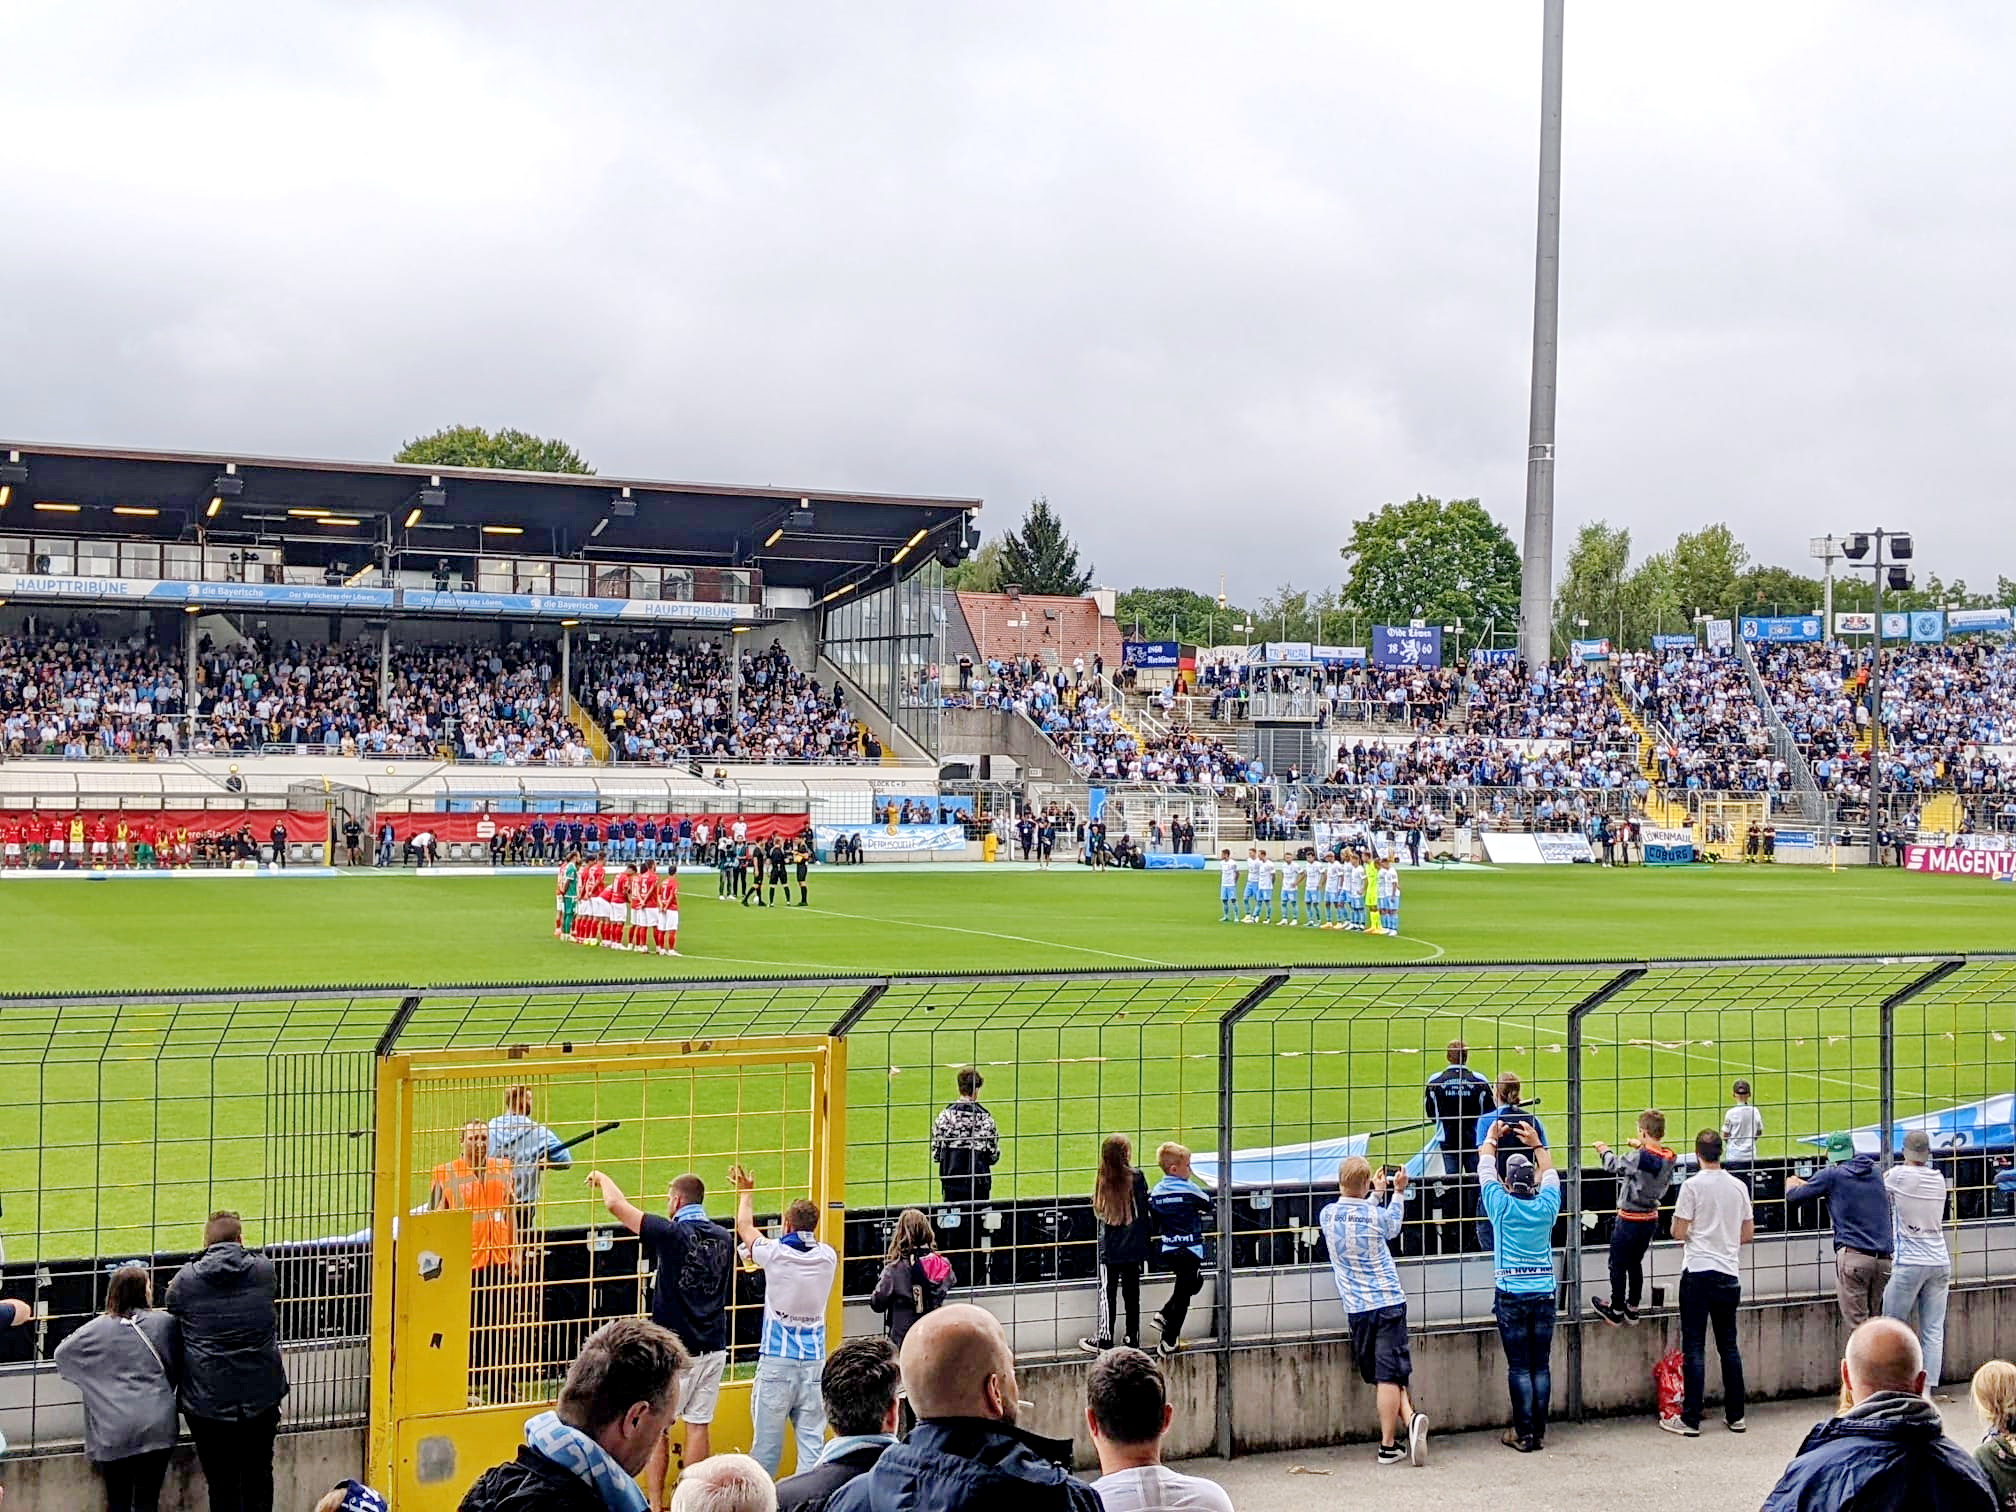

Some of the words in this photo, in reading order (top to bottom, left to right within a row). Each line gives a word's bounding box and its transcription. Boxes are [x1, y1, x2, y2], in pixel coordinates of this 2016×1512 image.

[15, 579, 128, 594] HAUPTTRIBÜNE
[202, 585, 216, 595] die
[217, 586, 264, 598] Bayerische
[289, 591, 300, 599] Der
[340, 592, 352, 600] der
[543, 598, 557, 608] die
[557, 599, 599, 610] Bayerische
[645, 602, 737, 617] HAUPTTRIBÜNE
[1387, 627, 1406, 638] Olde
[1408, 627, 1432, 638] Löwen
[1269, 648, 1309, 659] TRPICAL
[1387, 643, 1399, 654] 18
[1421, 643, 1433, 654] 60
[1642, 829, 1692, 843] LÖWENMAUL
[1650, 847, 1688, 861] COBURG
[641, 878, 648, 893] 5
[662, 885, 668, 900] 7
